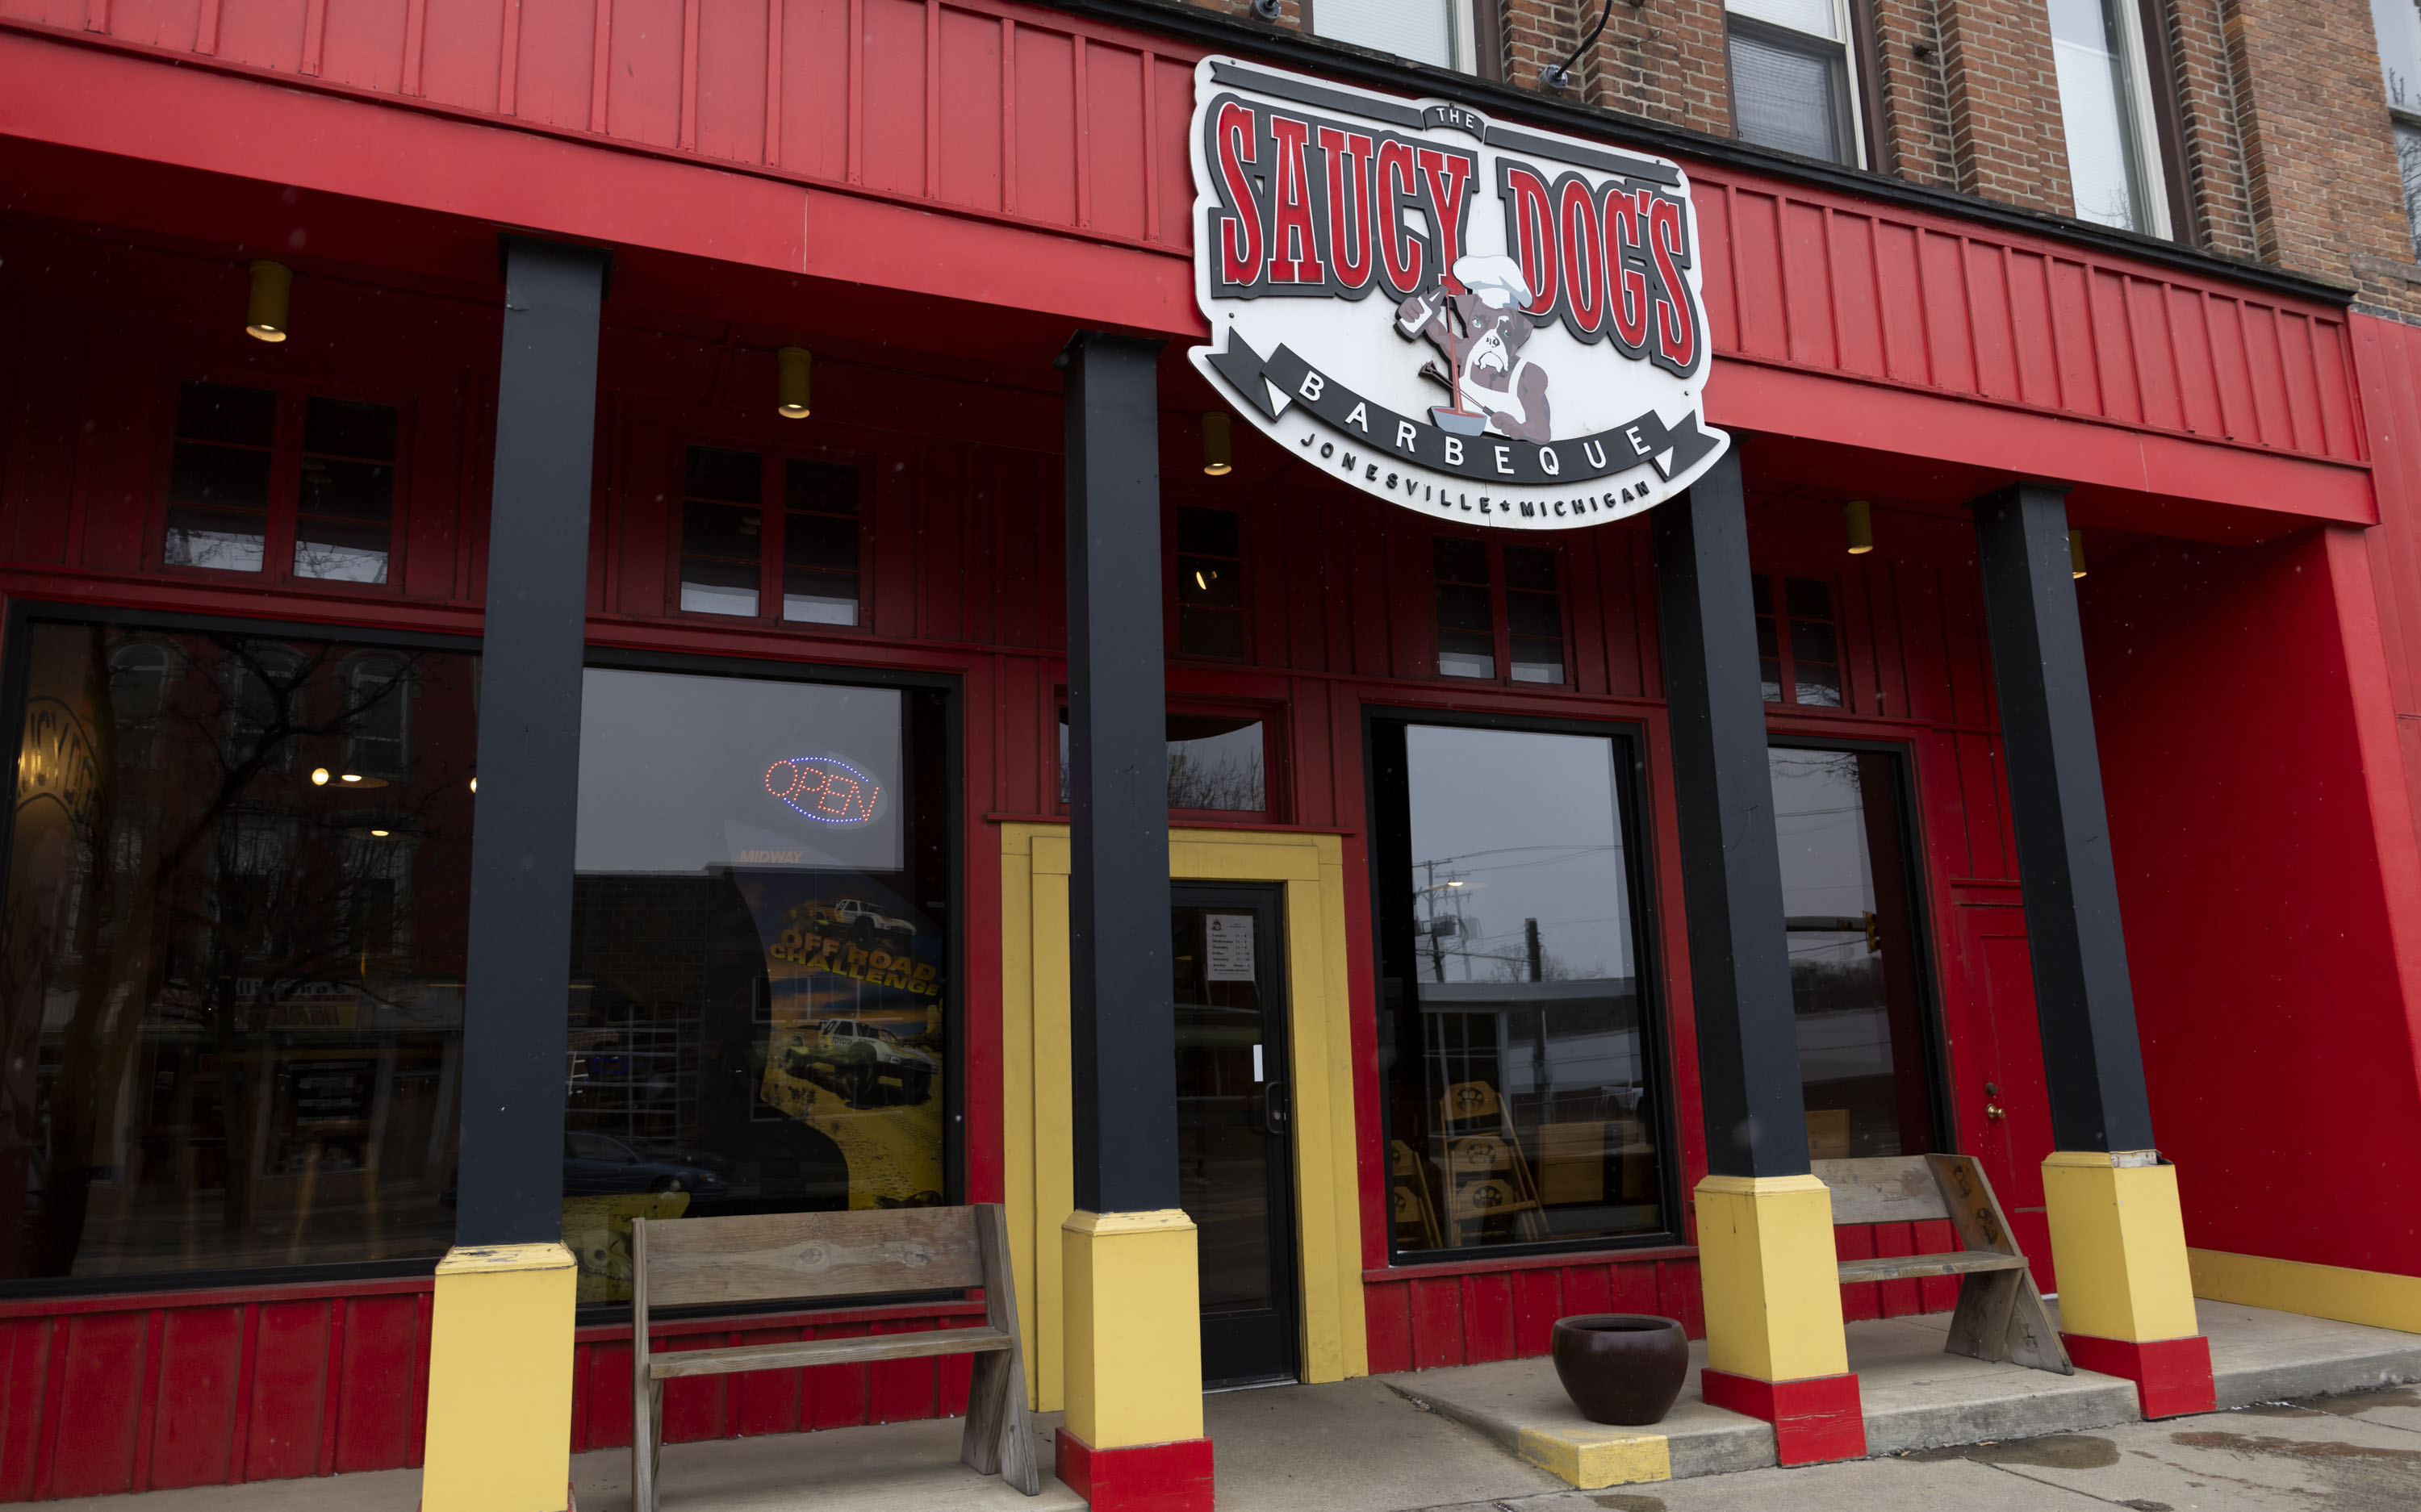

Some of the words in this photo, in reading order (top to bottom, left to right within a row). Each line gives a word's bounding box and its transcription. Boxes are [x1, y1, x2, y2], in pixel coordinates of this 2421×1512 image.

[1436, 107, 1475, 130] THE
[1217, 101, 1471, 297] SAUCY
[1507, 166, 1696, 368] DOG'S
[1298, 370, 1652, 476] BARBEQUE
[1300, 432, 1491, 514] JONESVILLE
[1521, 481, 1651, 518] MICHIGAN
[764, 759, 880, 823] OPEN
[739, 850, 805, 864] MIDWAY
[769, 942, 943, 998] CHALLENGE
[780, 929, 840, 957] OFF
[847, 946, 937, 982] ROAD
